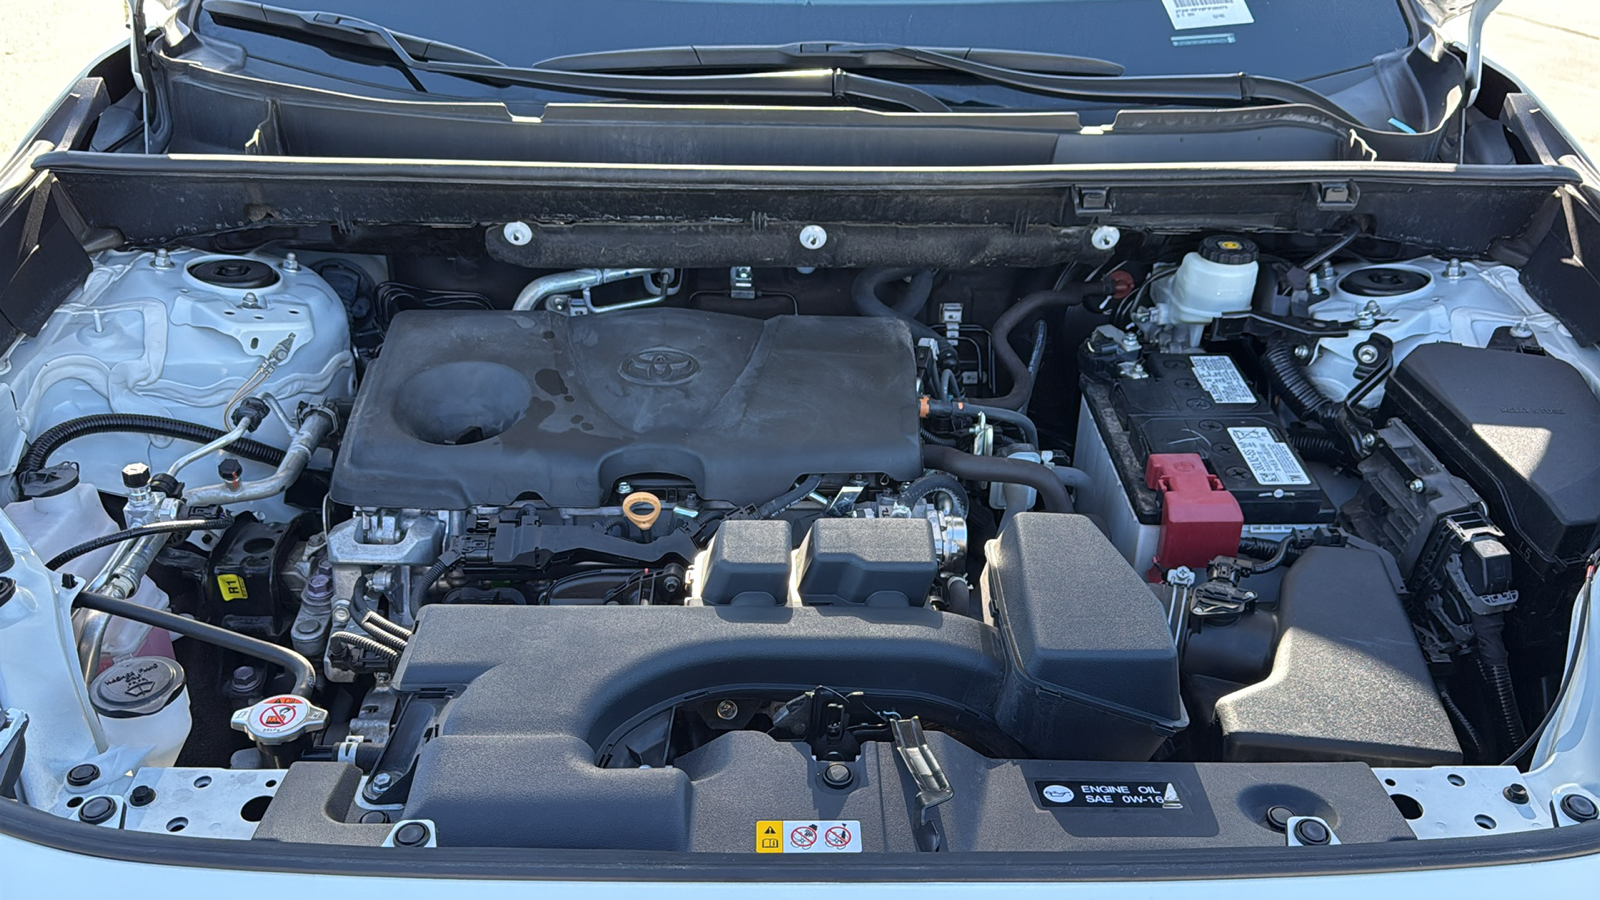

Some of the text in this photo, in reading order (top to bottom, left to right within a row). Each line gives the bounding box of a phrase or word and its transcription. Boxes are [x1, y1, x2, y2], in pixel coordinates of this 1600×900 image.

[226, 580, 239, 594] R1
[1081, 785, 1161, 795] ENGINE OIL
[1085, 795, 1164, 804] SAE 0W-16
